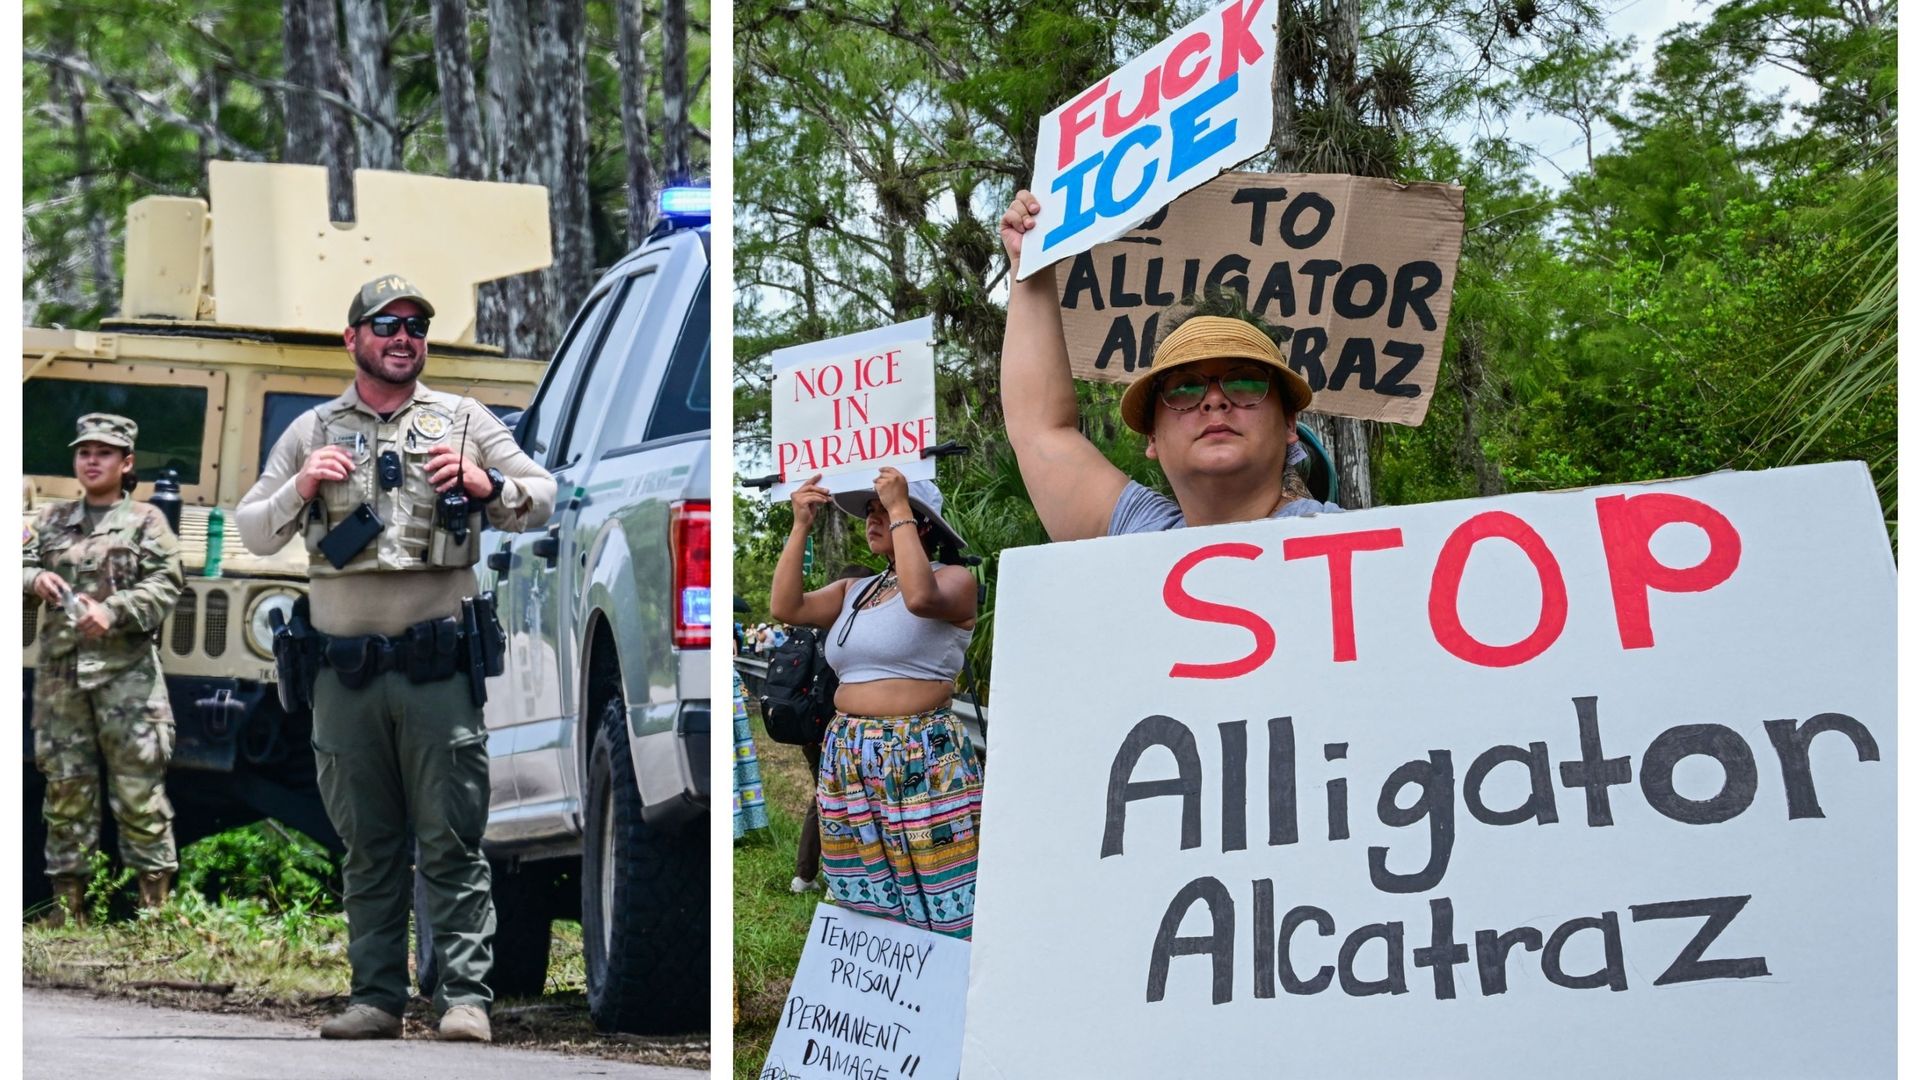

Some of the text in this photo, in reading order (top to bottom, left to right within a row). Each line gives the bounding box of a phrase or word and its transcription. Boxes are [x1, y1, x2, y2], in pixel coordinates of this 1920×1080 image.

[1057, 0, 1265, 171] FucK
[1042, 72, 1239, 252] ICE
[1231, 187, 1336, 250] TO
[1061, 252, 1443, 332] ALLIGATOR
[794, 350, 902, 402] NO ICE
[833, 393, 869, 431] IN
[777, 417, 934, 483] PARADISE
[1163, 493, 1742, 679] STOP
[1100, 695, 1881, 894] Alligator
[819, 916, 935, 979] TEMPORARY
[1146, 876, 1772, 1005] Alcatraz
[786, 996, 911, 1052] PERMANENT
